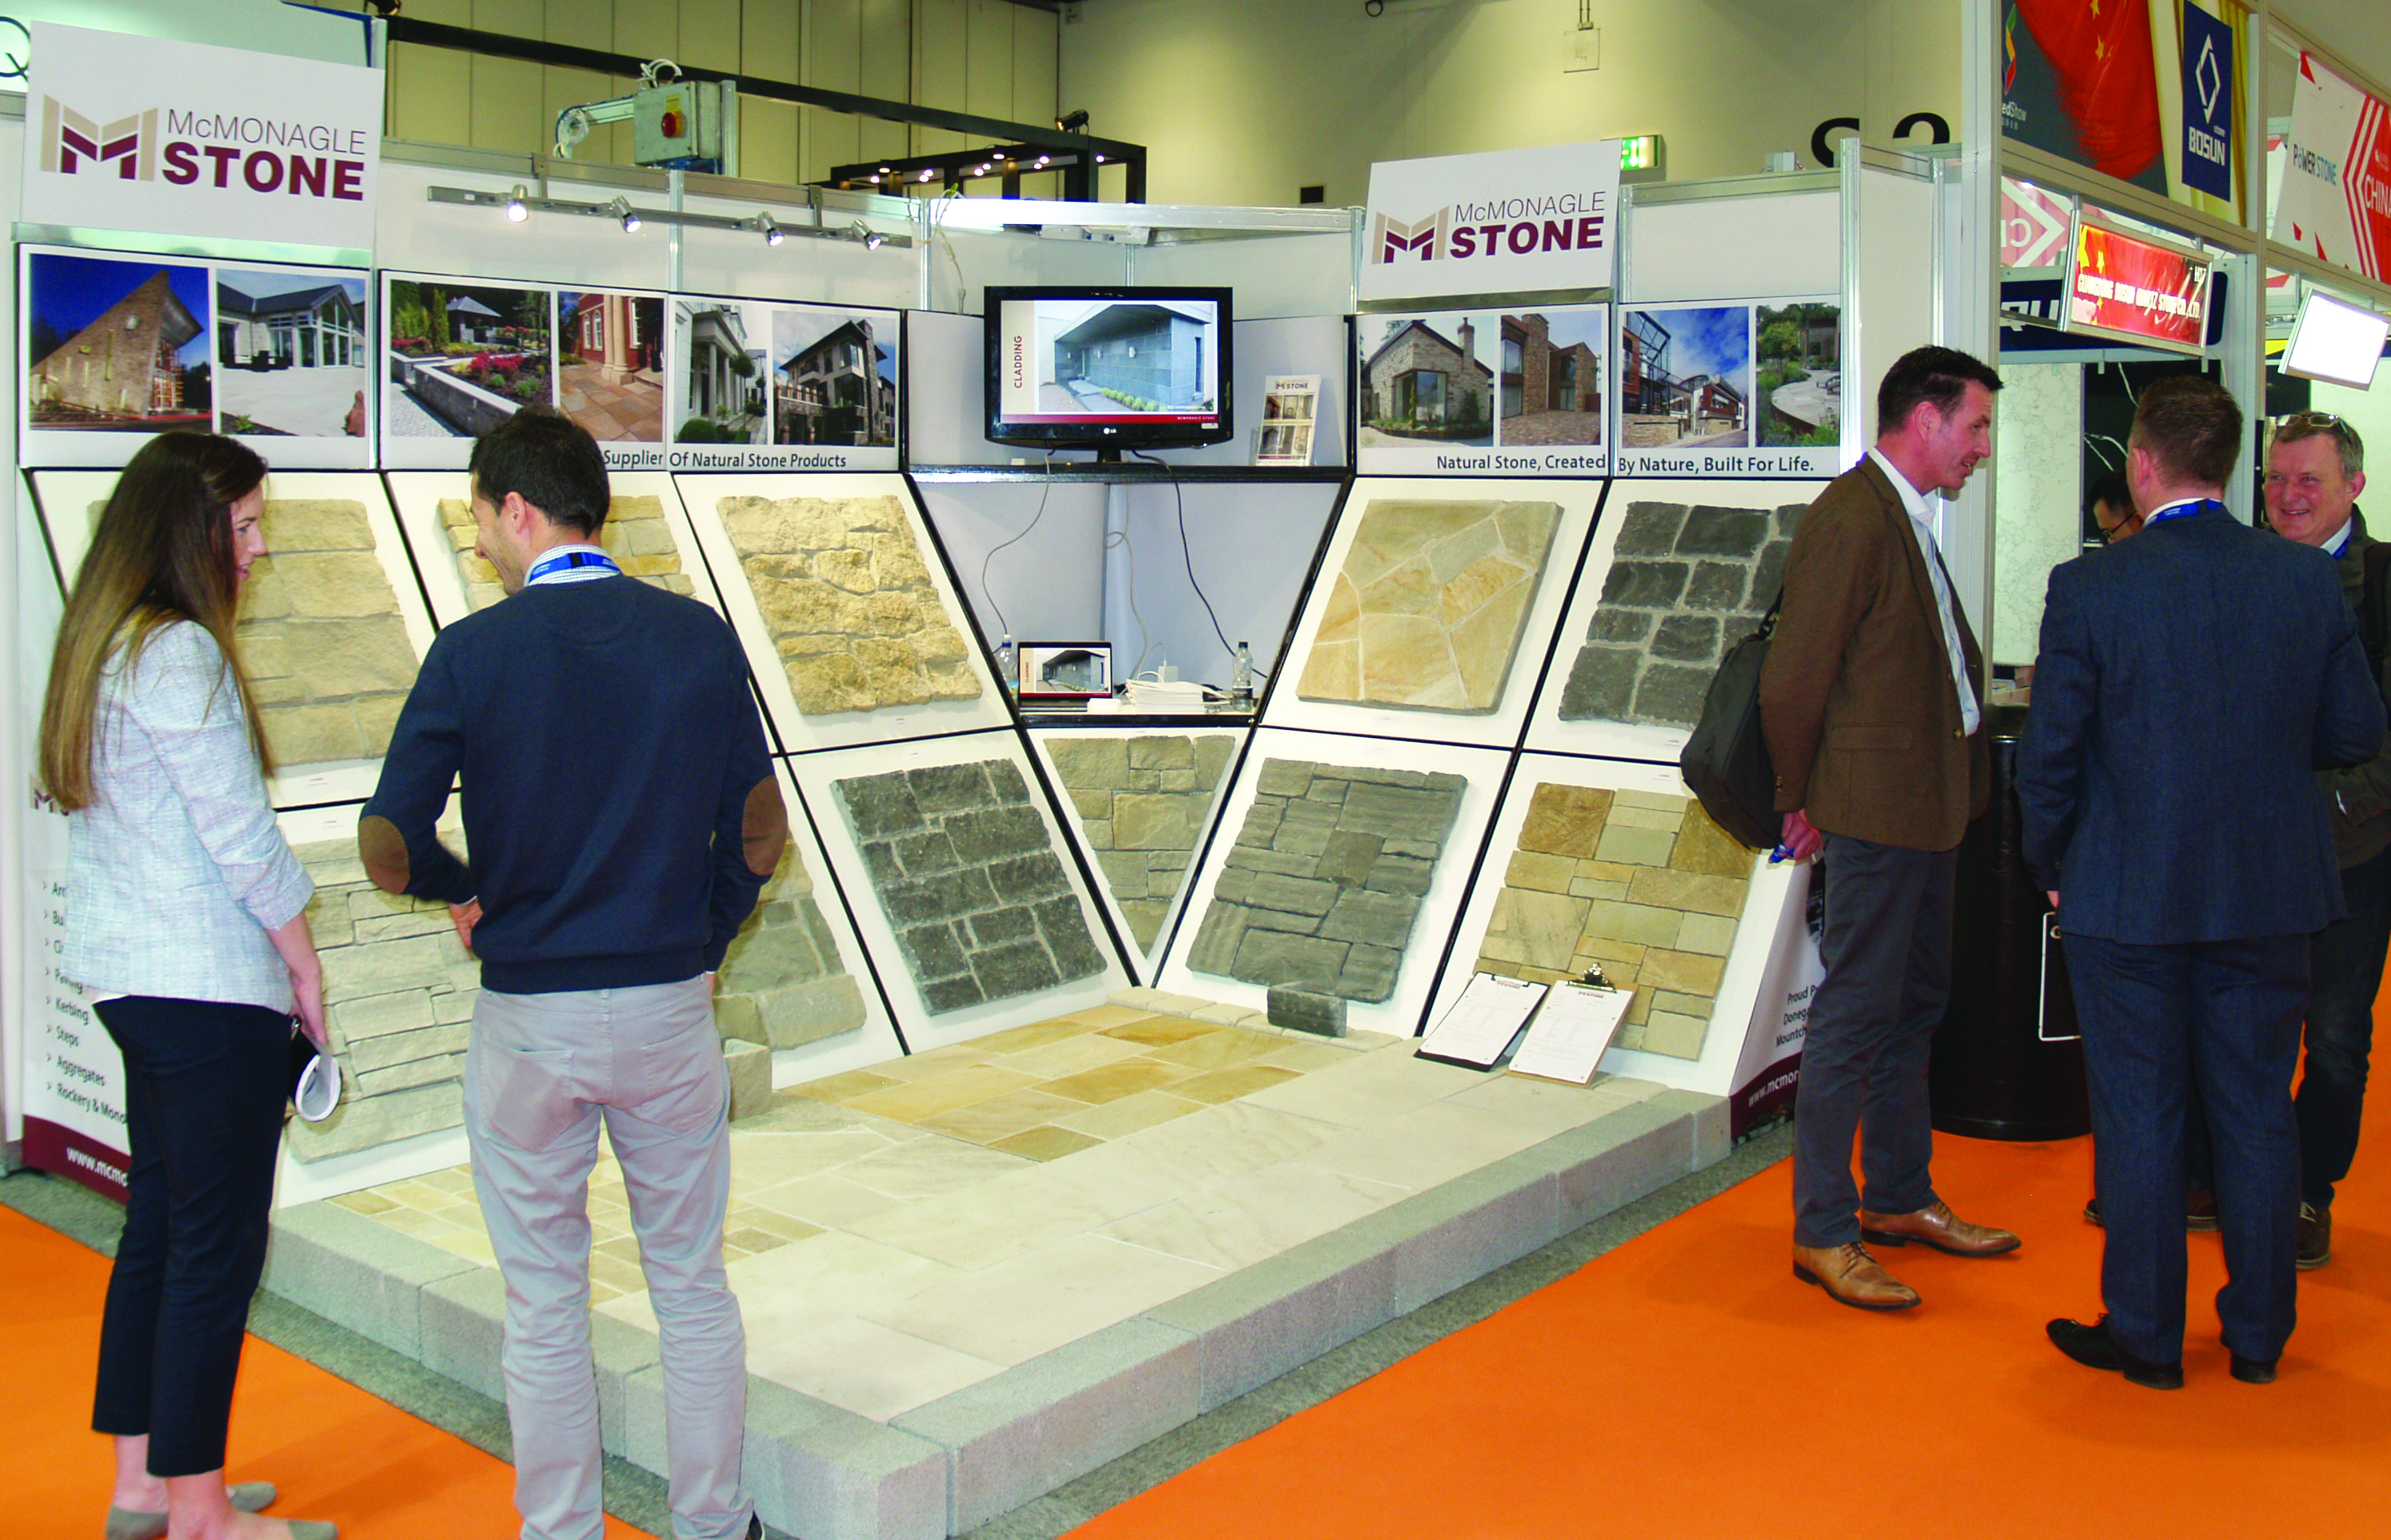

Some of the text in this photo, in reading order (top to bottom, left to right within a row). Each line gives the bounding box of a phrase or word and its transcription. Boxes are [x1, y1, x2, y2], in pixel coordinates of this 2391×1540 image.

[168, 108, 366, 155] McMONAGLE
[2188, 126, 2225, 166] BOSUN
[162, 142, 364, 201] STONE
[1455, 191, 1606, 223] McMONAGLE
[1450, 216, 1604, 259] STONE
[1014, 335, 1022, 389] CLADDING
[604, 450, 846, 468] Supplier Of Natural Stone Products
[1437, 454, 1606, 471] Natural Stone, Created
[1619, 455, 1814, 475] By Nature, Built For Life.
[1787, 986, 1809, 1005] Proud
[56, 997, 89, 1026] Kerbing
[1783, 1008, 1810, 1026] Doneg
[56, 1025, 78, 1048] Steps
[57, 1055, 106, 1087] Aggregates
[57, 1083, 90, 1113] Rockery
[92, 1099, 98, 1113] &
